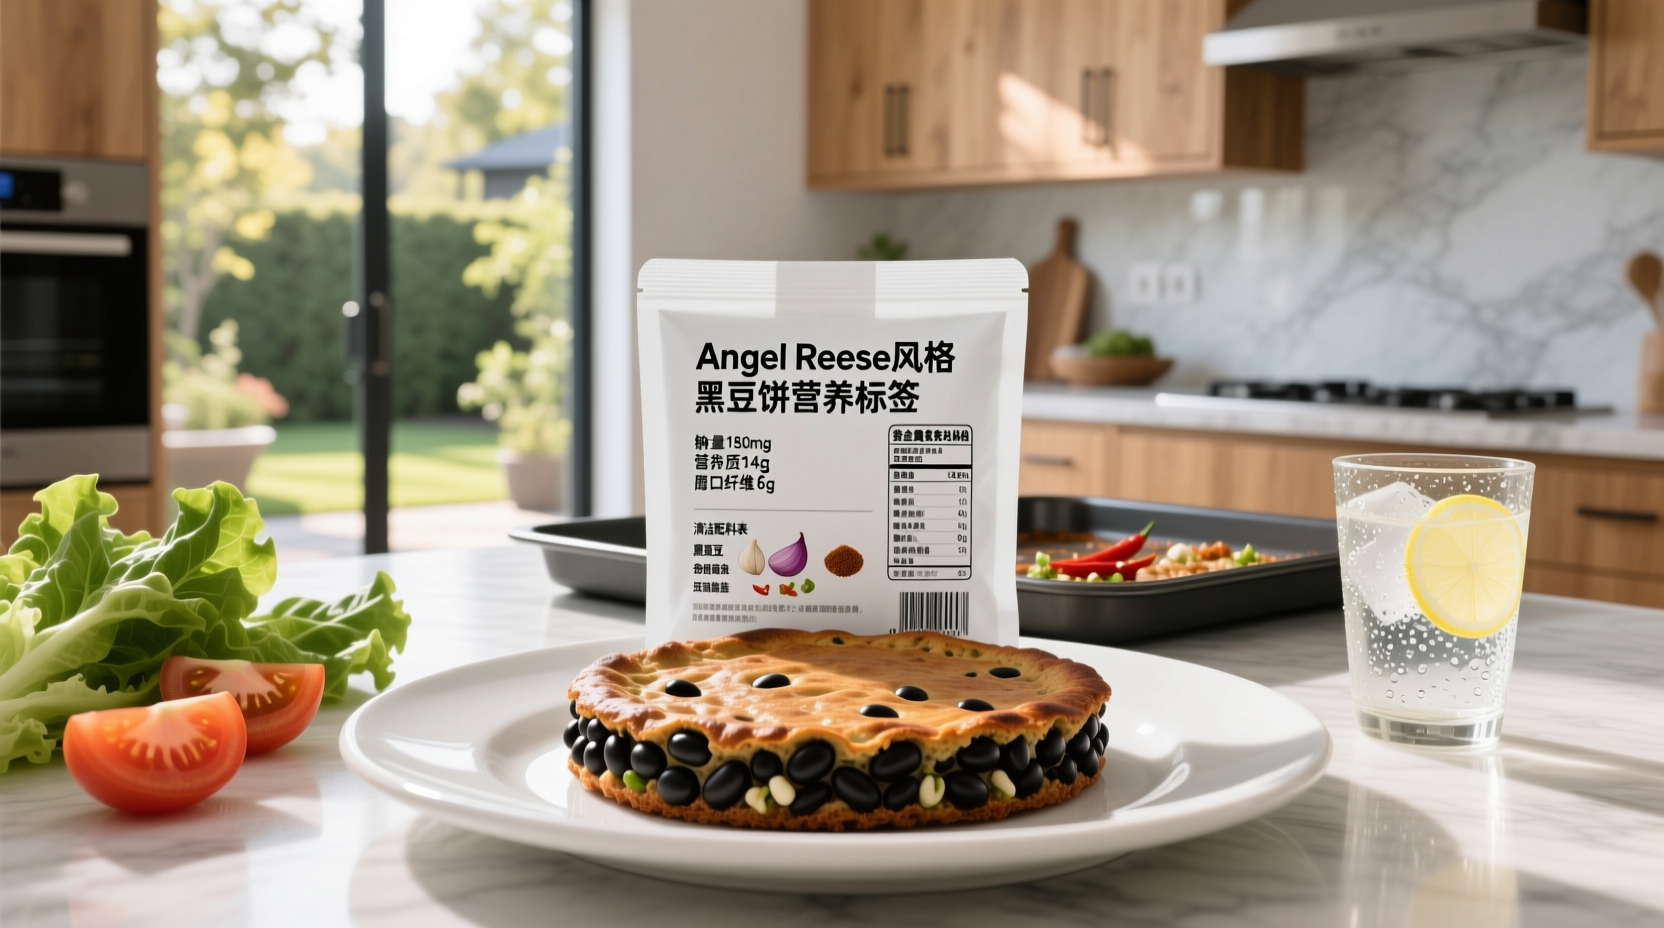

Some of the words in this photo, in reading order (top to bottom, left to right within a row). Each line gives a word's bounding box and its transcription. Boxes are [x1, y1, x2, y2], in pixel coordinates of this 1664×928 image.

[696, 342, 786, 377] Angel
[796, 340, 955, 374] Reese风格
[695, 379, 920, 415] 黑豆饼营养标签
